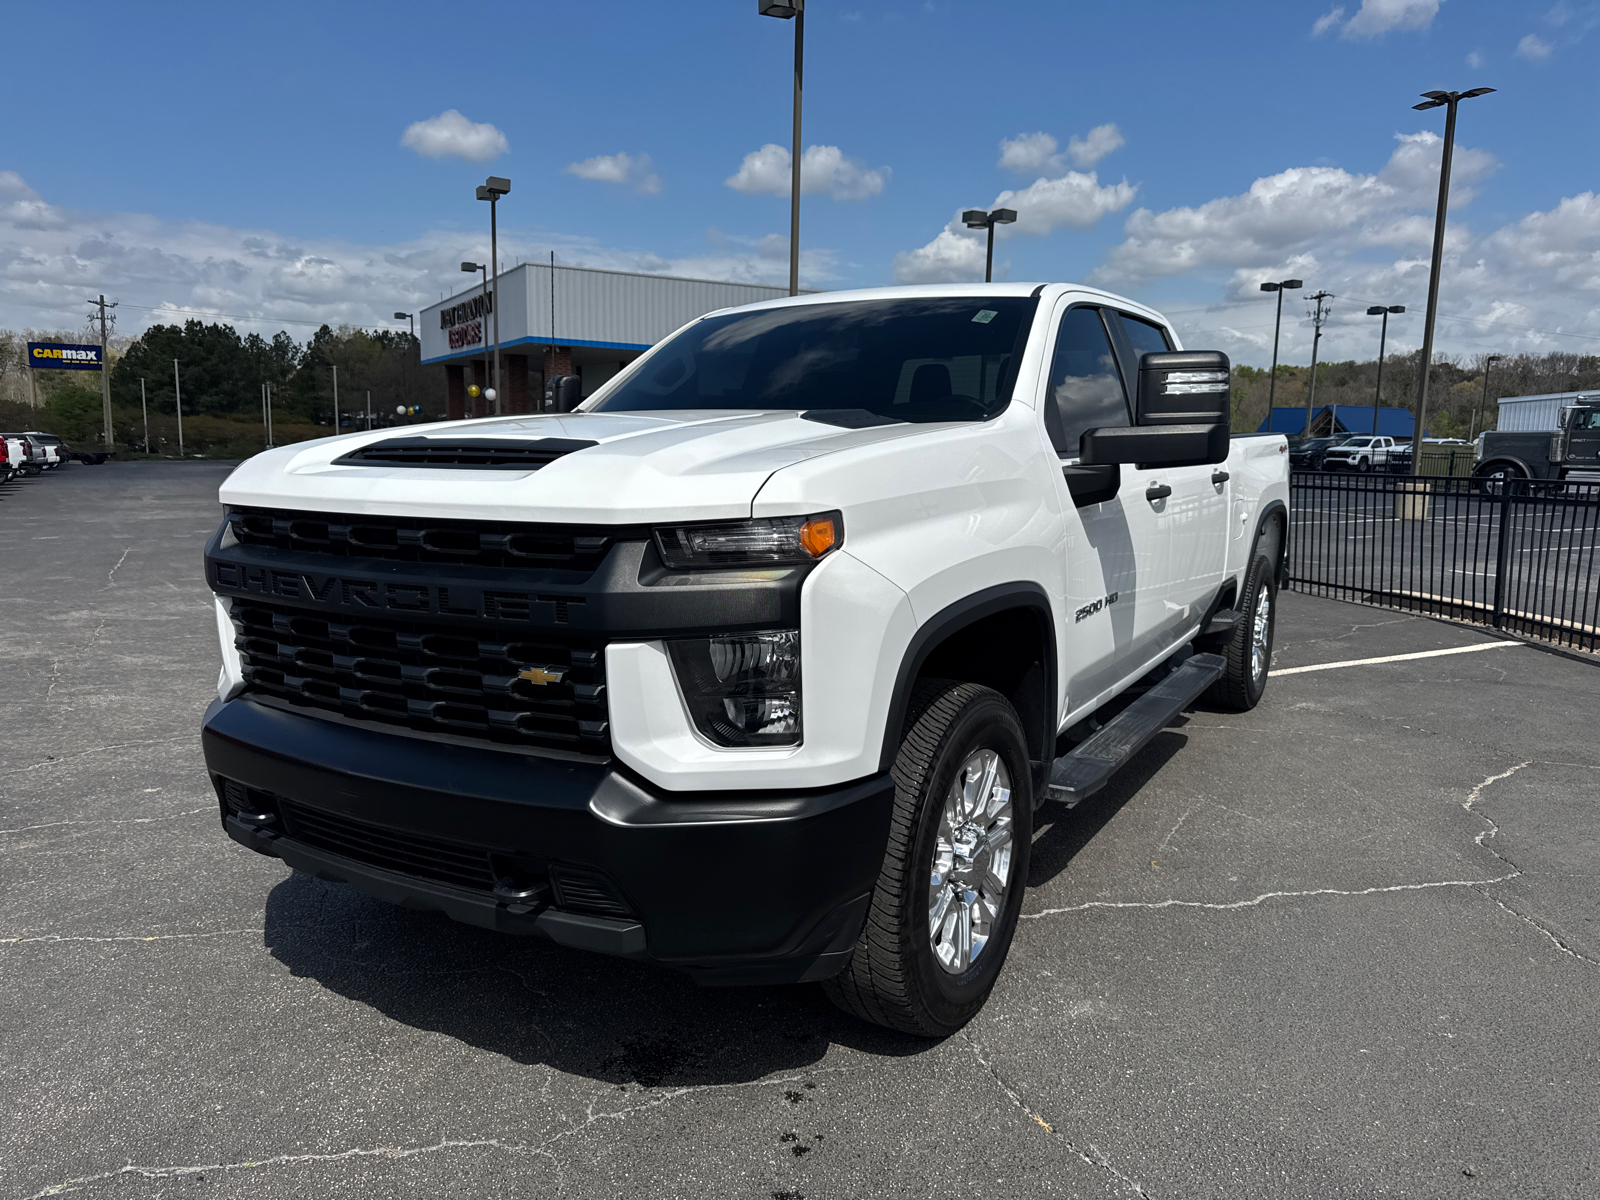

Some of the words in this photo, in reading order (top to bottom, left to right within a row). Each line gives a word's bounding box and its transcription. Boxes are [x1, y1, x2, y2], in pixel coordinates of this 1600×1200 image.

[216, 561, 587, 624] CHEVROLET
[1074, 599, 1102, 624] 2500
[1104, 592, 1118, 608] HD
